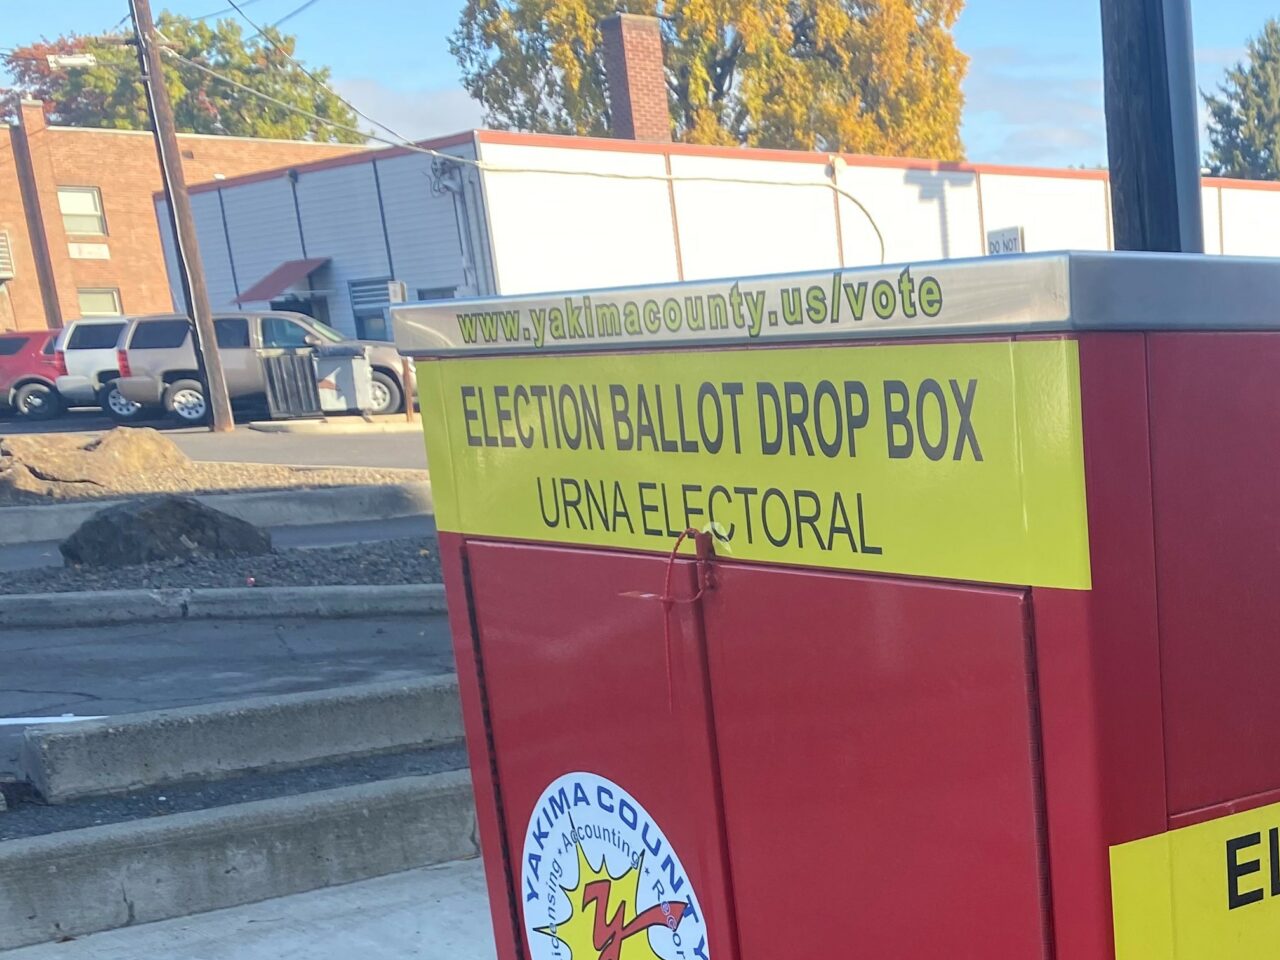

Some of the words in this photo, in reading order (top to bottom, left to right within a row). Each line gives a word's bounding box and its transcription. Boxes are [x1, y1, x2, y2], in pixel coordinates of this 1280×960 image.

[990, 240, 1000, 254] DO
[1002, 237, 1017, 253] NOT
[457, 266, 943, 348] www.yakimacounty.us/vote
[460, 383, 606, 451] ELECTION
[609, 381, 743, 455] BALLOT
[756, 379, 869, 459] DROP
[885, 378, 984, 463] BOX
[537, 476, 634, 534] URNA
[639, 483, 883, 556] ELECTORAL
[526, 782, 591, 903] YAKIMA
[561, 824, 641, 870] Accounting
